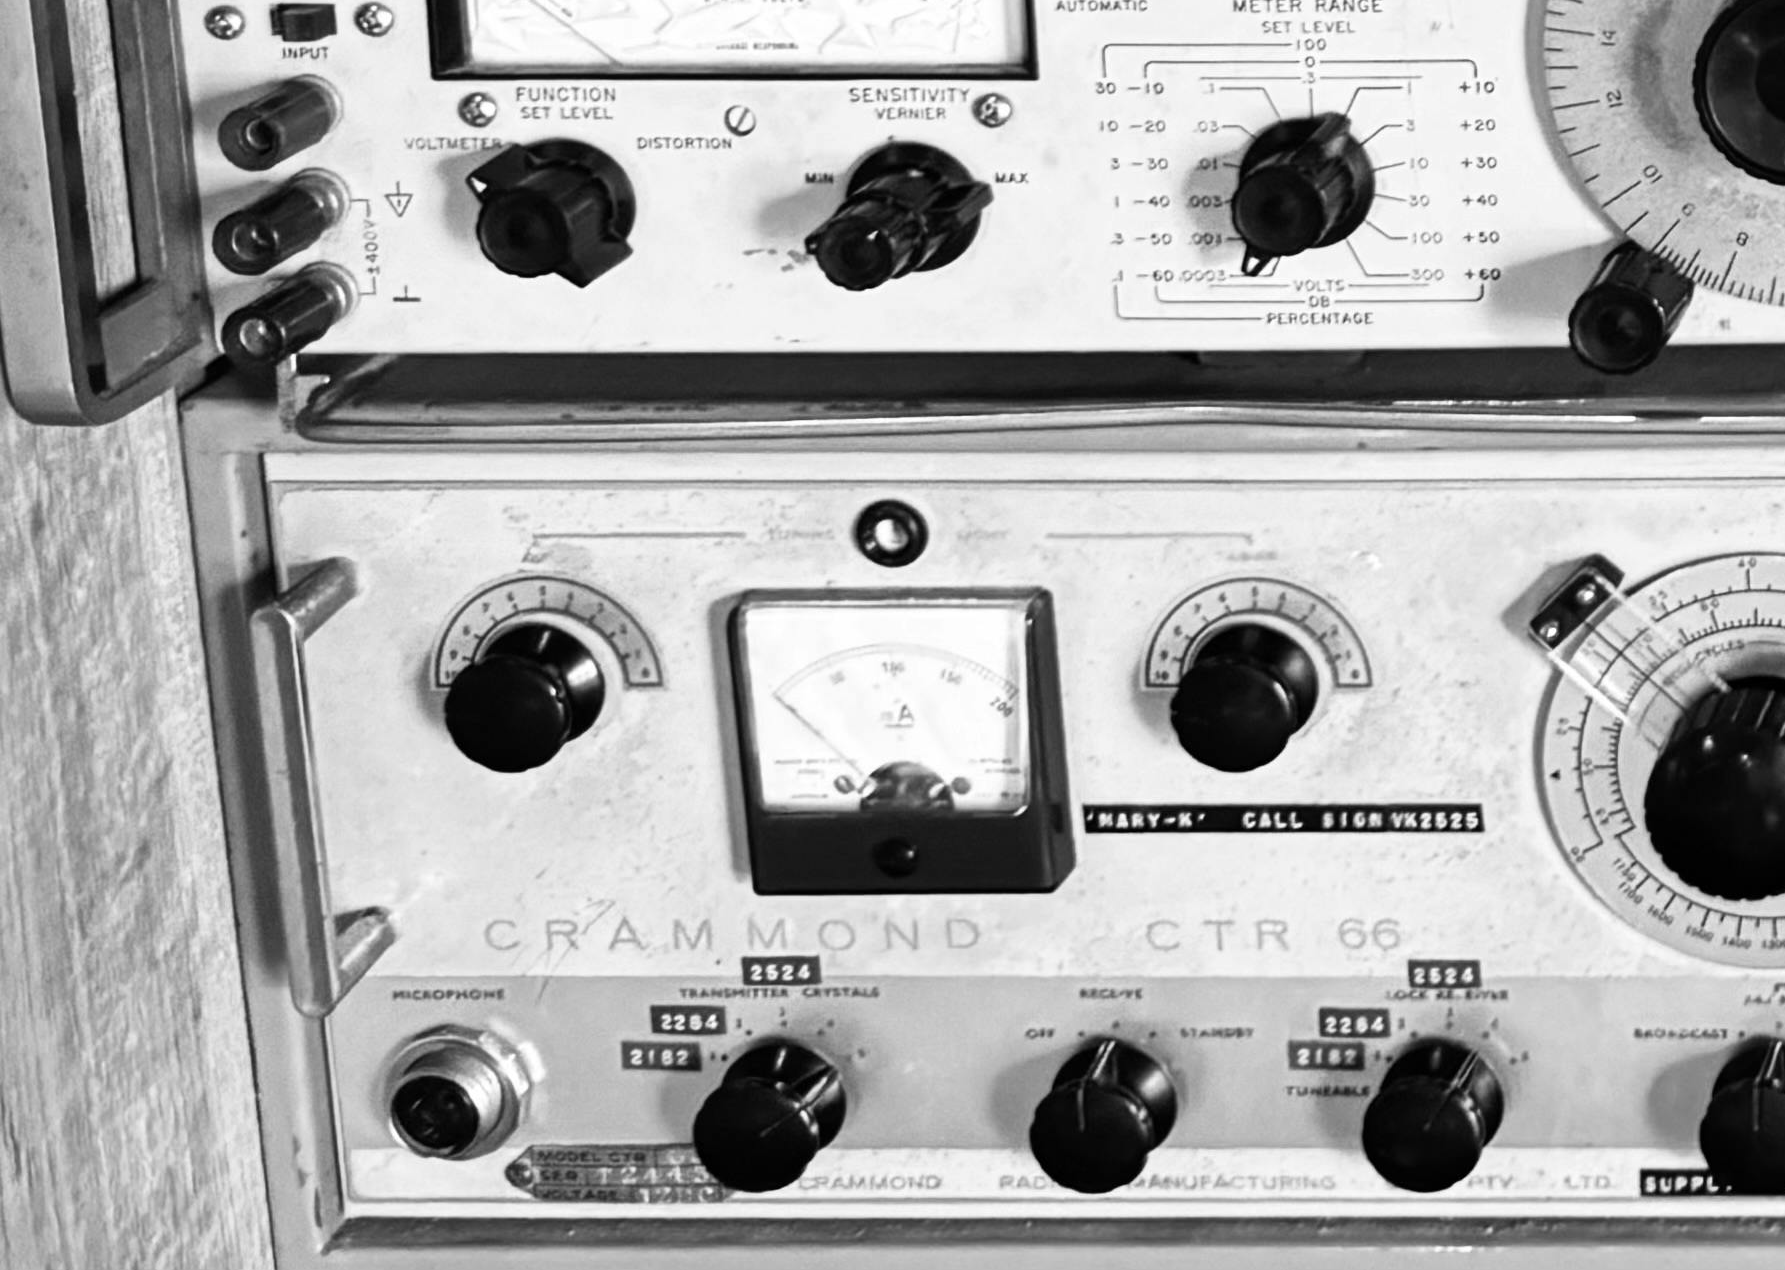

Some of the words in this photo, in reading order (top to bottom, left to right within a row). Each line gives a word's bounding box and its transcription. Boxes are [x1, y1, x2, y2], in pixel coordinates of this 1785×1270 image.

[516, 87, 616, 102] FUNCTION
[849, 87, 969, 103] SENSITIVITY
[521, 107, 550, 119] SET
[560, 107, 613, 120] LEVEL
[637, 137, 732, 149] DISTORTION
[1243, 812, 1302, 828] CALL
[1323, 812, 1382, 828] SIGN
[484, 913, 981, 952] CRAMMOND
[1338, 918, 1401, 952] 66
[751, 964, 810, 980] 2524
[1415, 967, 1473, 984] 2524
[631, 1049, 688, 1065] 2182
